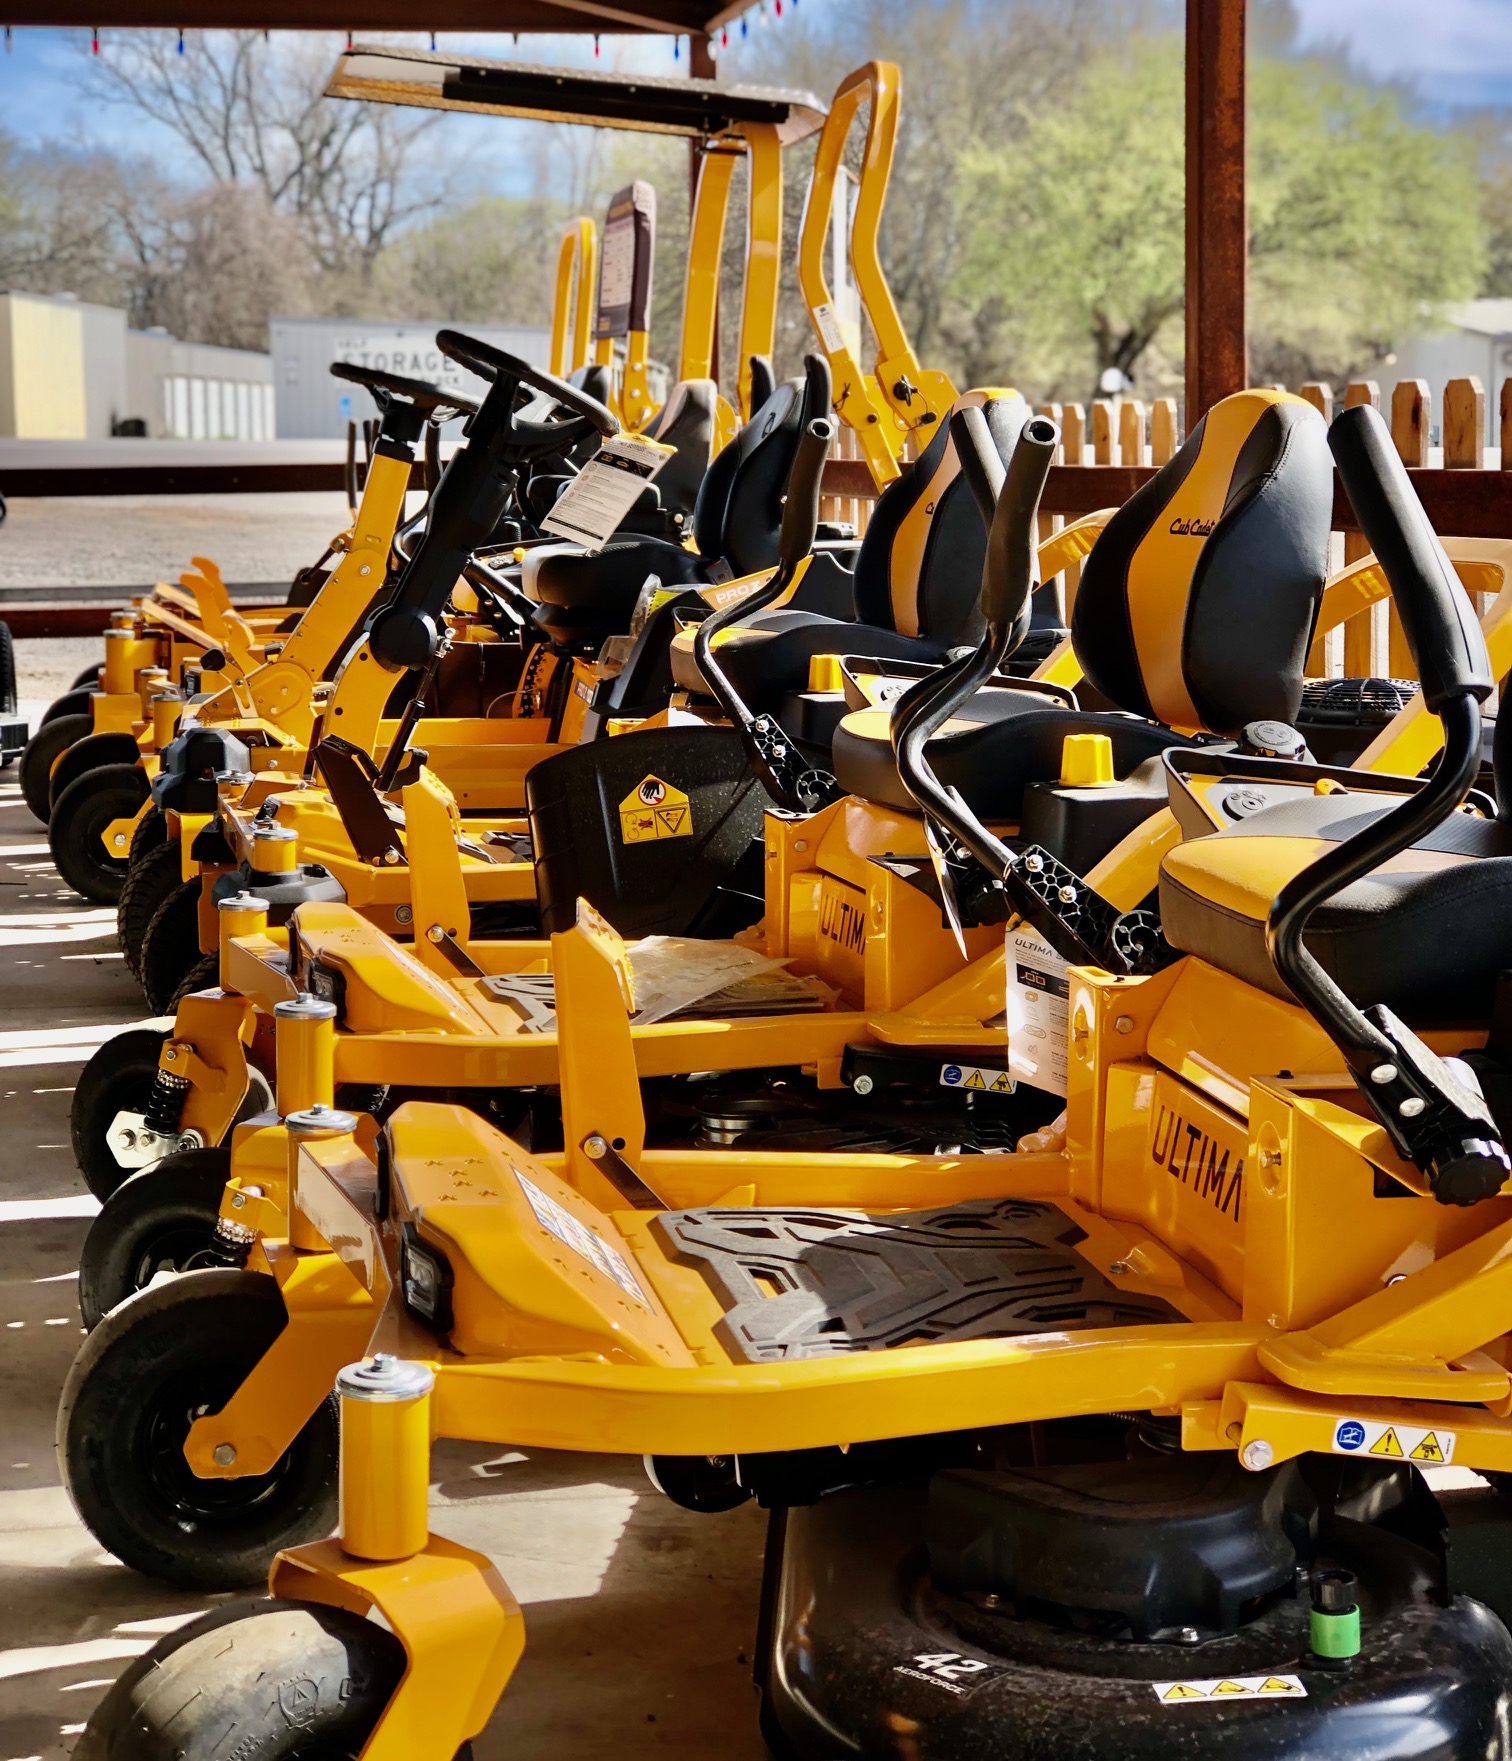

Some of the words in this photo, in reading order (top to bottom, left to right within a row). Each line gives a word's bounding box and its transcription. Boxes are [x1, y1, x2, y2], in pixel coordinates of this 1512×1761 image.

[1169, 518, 1190, 535] Cub
[715, 584, 750, 605] PRO
[821, 894, 867, 956] ULTIM
[1014, 937, 1053, 957] ULTIMA
[1152, 1105, 1244, 1223] ULTIMA
[892, 1665, 966, 1695] AEROFORCE
[913, 1653, 988, 1680] 42
